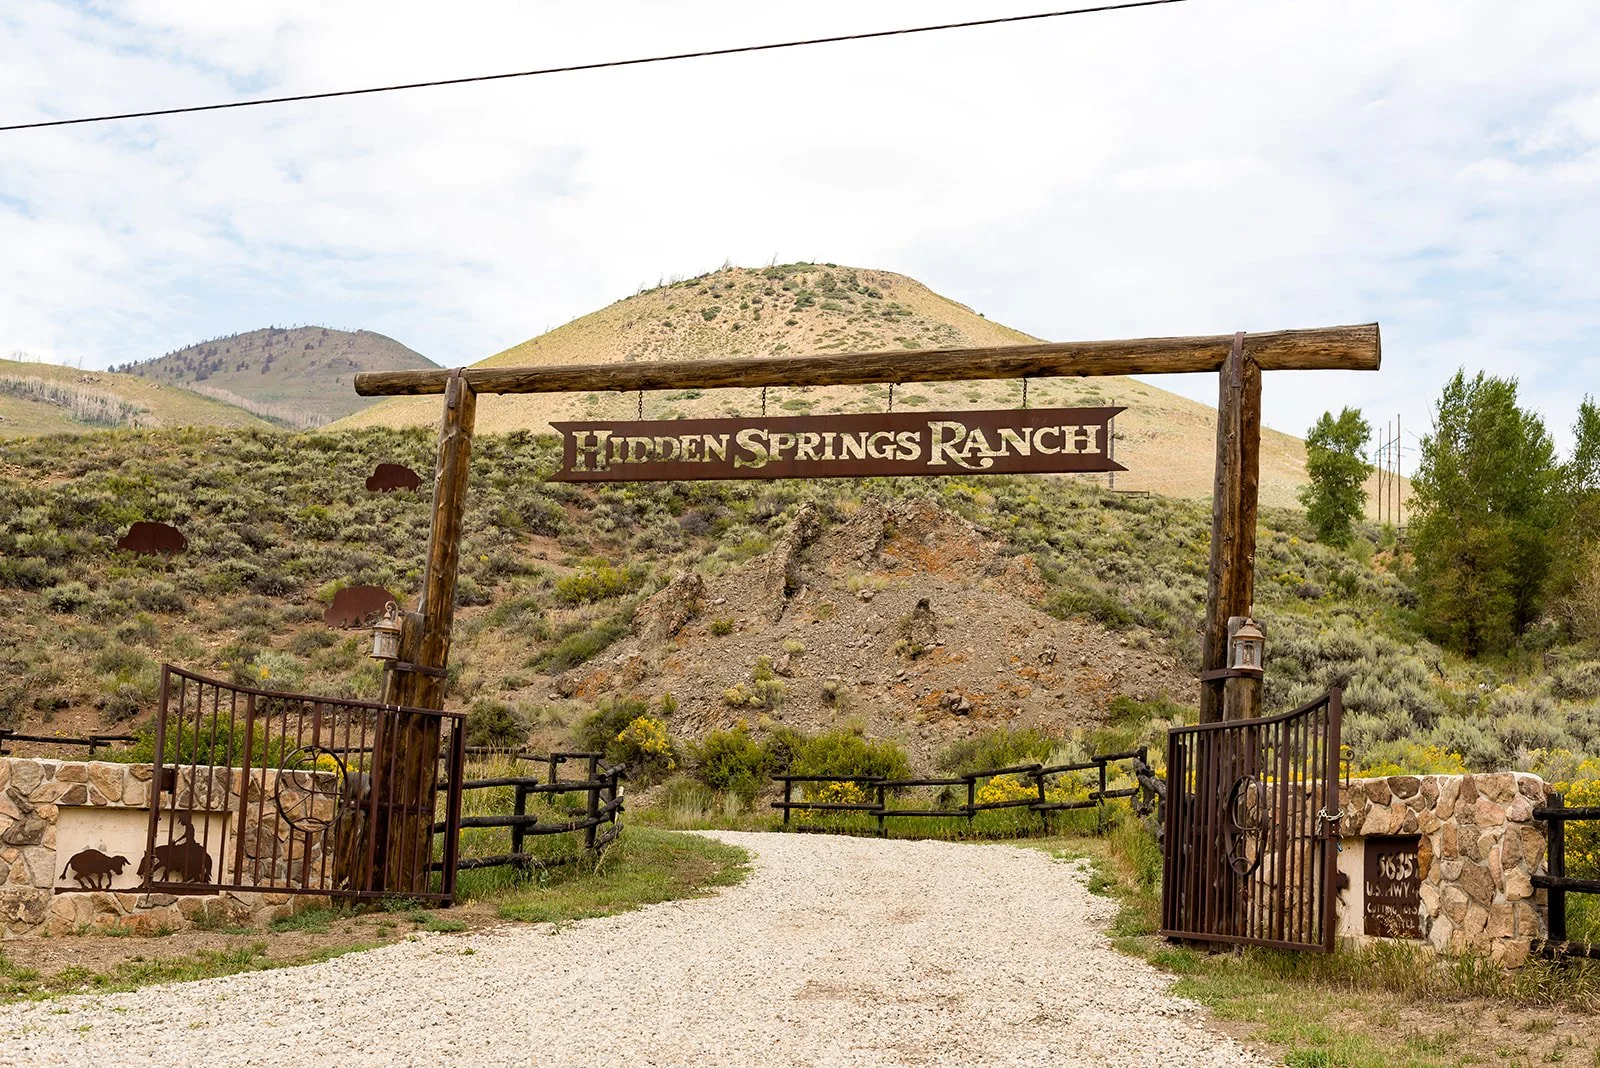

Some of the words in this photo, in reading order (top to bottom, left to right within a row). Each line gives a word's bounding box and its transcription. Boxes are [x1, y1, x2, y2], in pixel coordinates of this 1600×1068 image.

[571, 430, 730, 472] HIDDEN
[734, 428, 920, 469] SPRINGS
[927, 421, 1101, 470] RANCH
